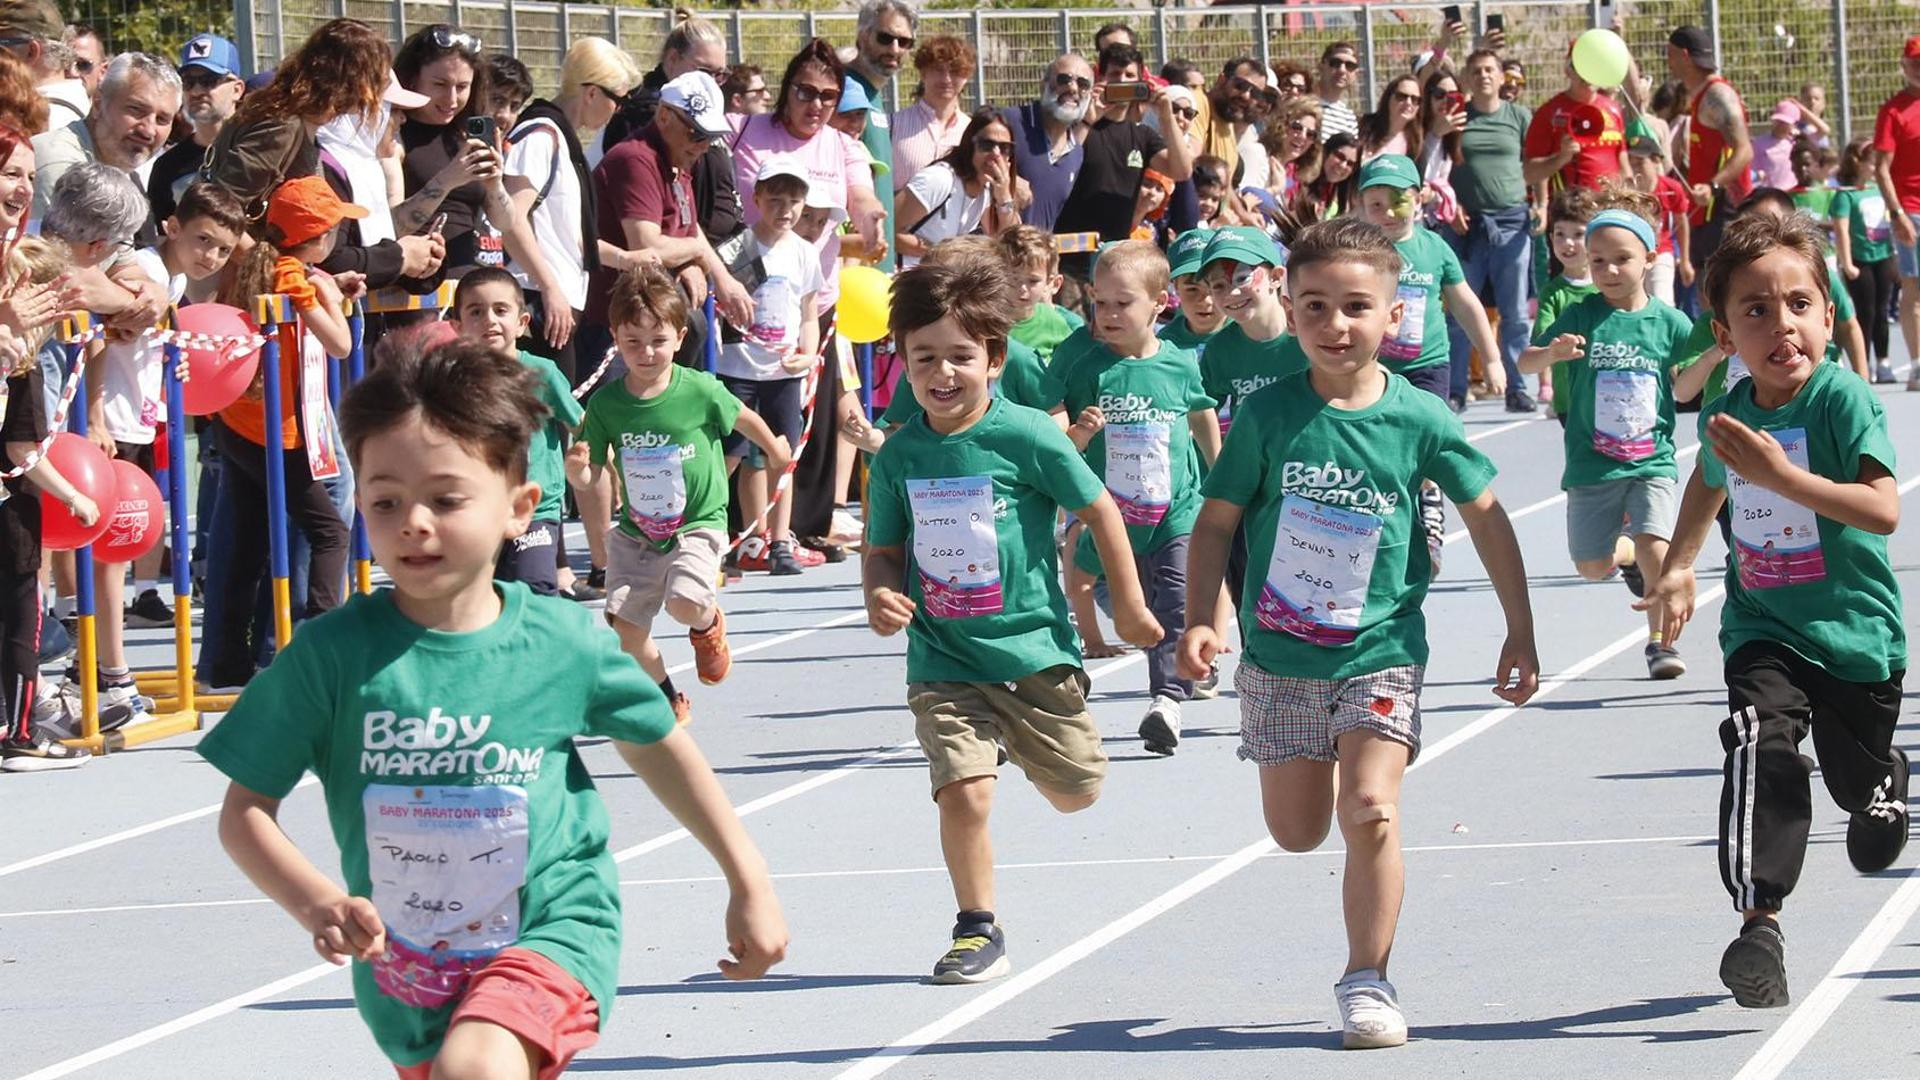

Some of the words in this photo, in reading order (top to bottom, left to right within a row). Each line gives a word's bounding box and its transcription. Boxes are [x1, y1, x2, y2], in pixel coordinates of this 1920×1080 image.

[1590, 341, 1640, 358] Baby
[1589, 356, 1659, 369] MARATONA
[1099, 391, 1153, 411] Baby
[621, 430, 671, 447] Baby
[1282, 461, 1365, 488] Baby
[929, 489, 966, 499] MARATONA
[967, 488, 985, 497] 2025
[1290, 507, 1310, 521] BABY
[1310, 515, 1353, 535] MARATONA
[1743, 508, 1773, 520] 2020
[930, 547, 965, 558] 2020
[1289, 535, 1336, 558] DENNIS
[1294, 569, 1333, 590] 2020
[364, 707, 492, 750] Baby
[360, 741, 545, 777] MARATONA
[379, 804, 409, 817] BABY
[413, 806, 481, 819] MARATONA
[484, 805, 514, 818] 2025
[381, 845, 449, 864] PAOLO
[404, 891, 464, 912] 2020
